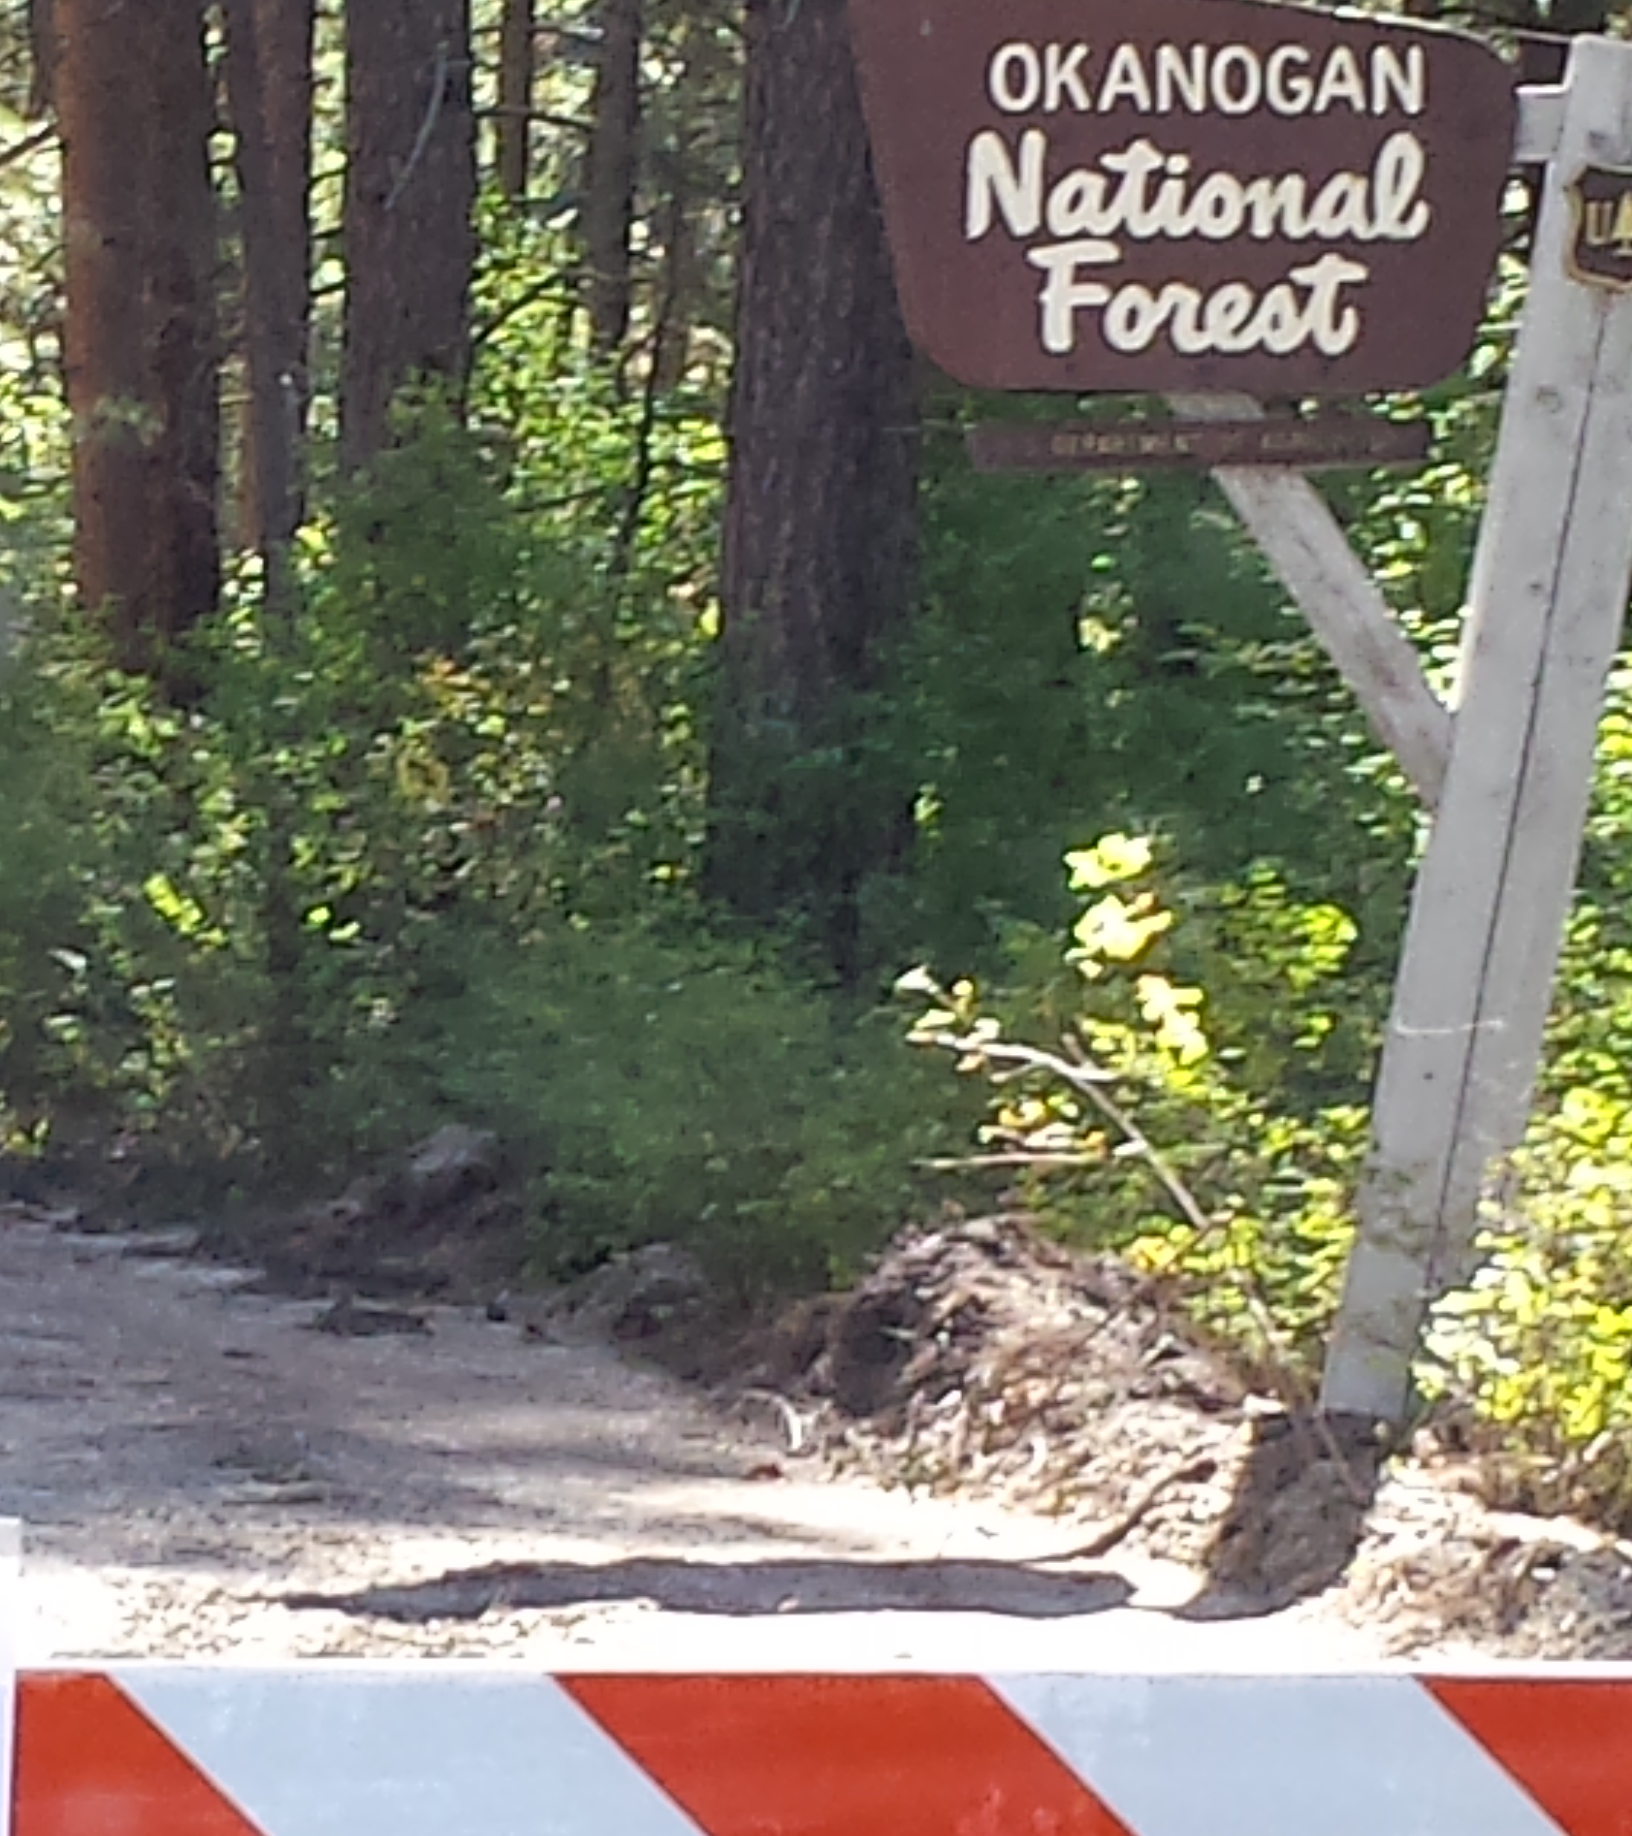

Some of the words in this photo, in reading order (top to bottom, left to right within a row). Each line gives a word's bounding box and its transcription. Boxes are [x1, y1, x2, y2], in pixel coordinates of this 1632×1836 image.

[990, 43, 1425, 115] OKANOGAN
[966, 130, 1429, 240] National
[1029, 240, 1369, 355] Forest
